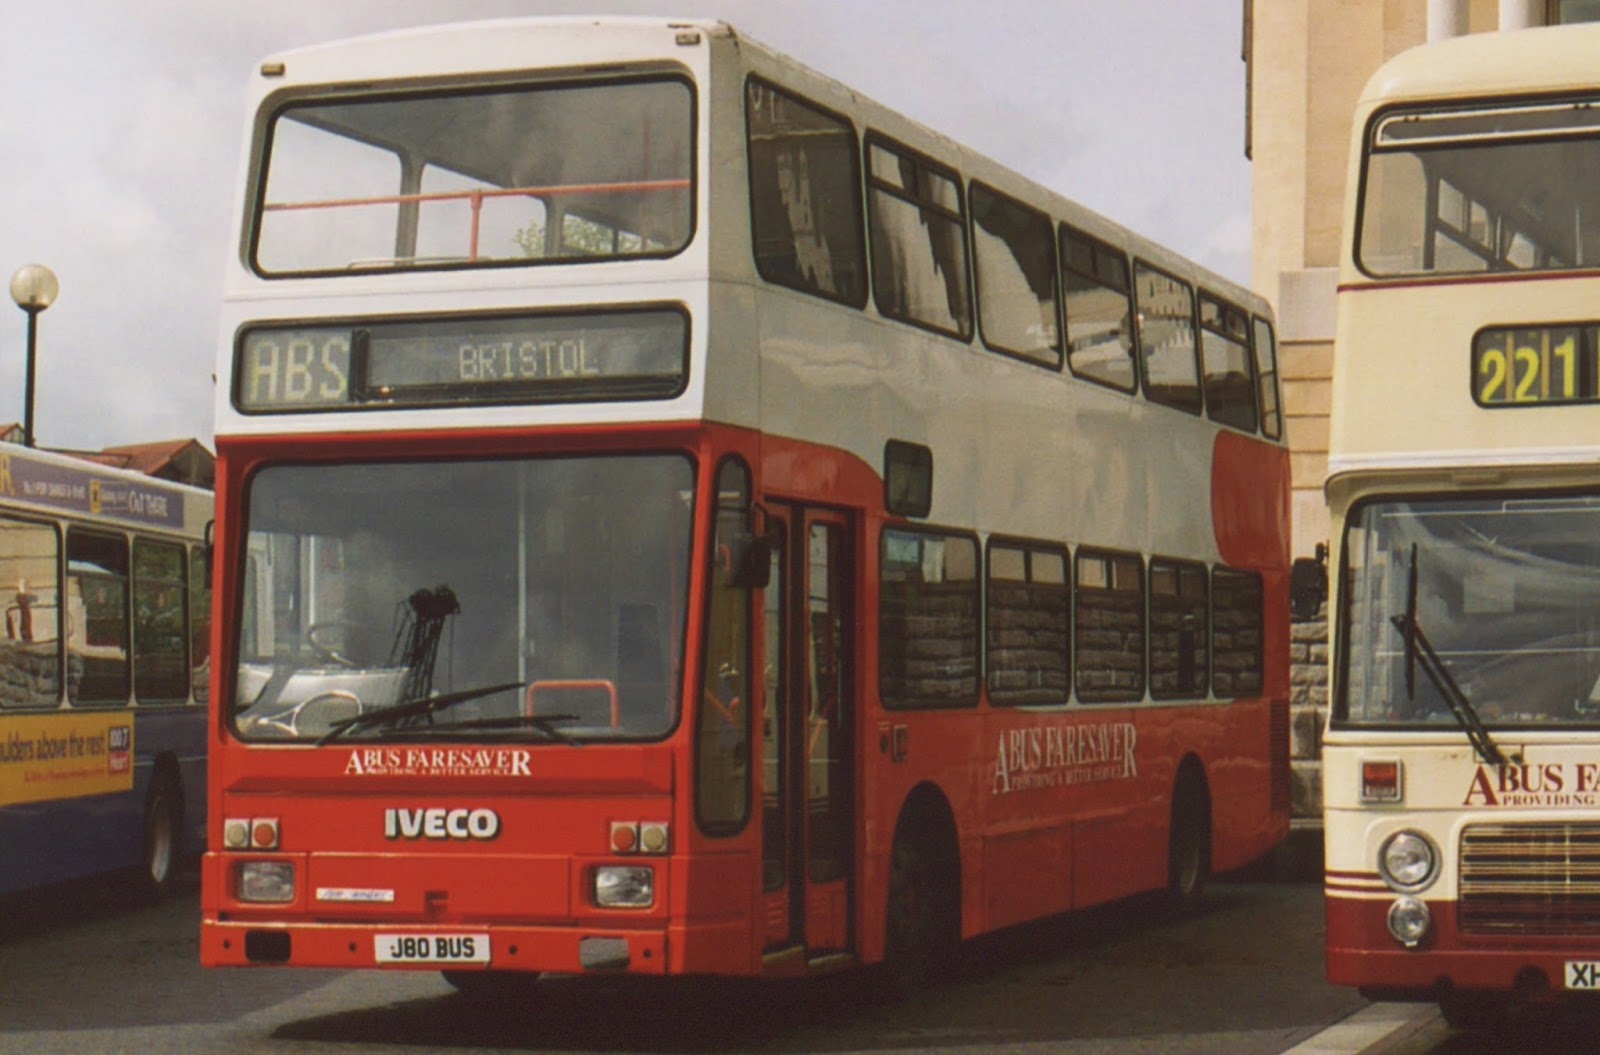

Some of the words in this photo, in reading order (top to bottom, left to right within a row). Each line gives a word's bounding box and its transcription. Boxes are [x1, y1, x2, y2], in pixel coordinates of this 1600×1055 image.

[249, 337, 350, 401] ABS
[458, 339, 599, 381] BRISTOL
[1480, 336, 1575, 404] 221
[344, 750, 401, 775] ABUS
[407, 750, 532, 776] FARESAVER
[992, 728, 1043, 795] ABUS
[1046, 722, 1138, 778] FARESAVER
[1462, 762, 1563, 806] ABUS
[1503, 794, 1596, 806] PROVIDING
[384, 808, 498, 838] IVECO
[391, 937, 429, 958] J80
[436, 937, 475, 958] BUS
